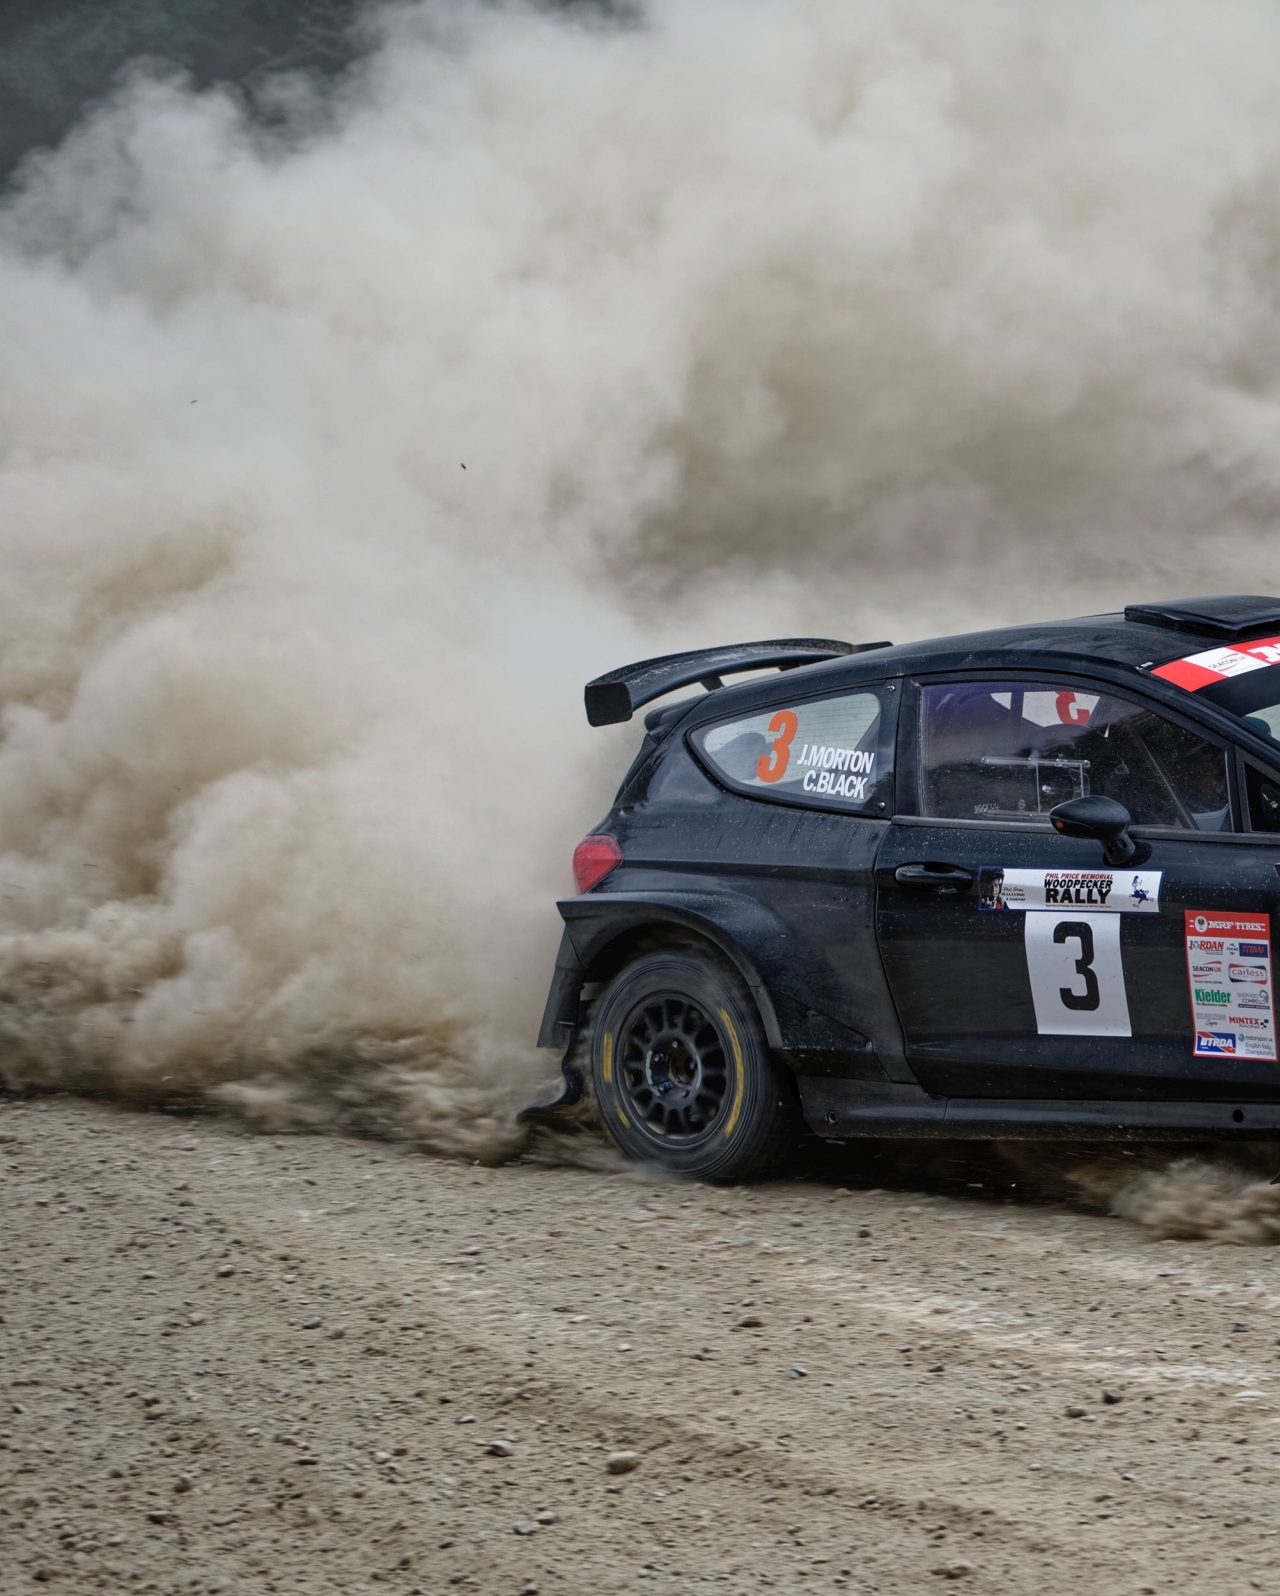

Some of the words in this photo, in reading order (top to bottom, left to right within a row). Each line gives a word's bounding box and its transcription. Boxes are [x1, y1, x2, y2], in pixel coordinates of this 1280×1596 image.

[757, 709, 798, 784] 3
[797, 744, 875, 775] J.MORTON
[803, 769, 868, 800] C.BLACK
[1044, 879, 1113, 889] WOODPECKER
[1045, 888, 1111, 904] RALLY
[1208, 920, 1234, 930] MRF
[1235, 922, 1262, 931] TYRES
[1053, 920, 1101, 1012] 3
[1232, 967, 1264, 977] carless
[1195, 989, 1231, 1003] Kielder
[1229, 1016, 1260, 1025] MINTEX
[1200, 1037, 1234, 1047] BTRDA
